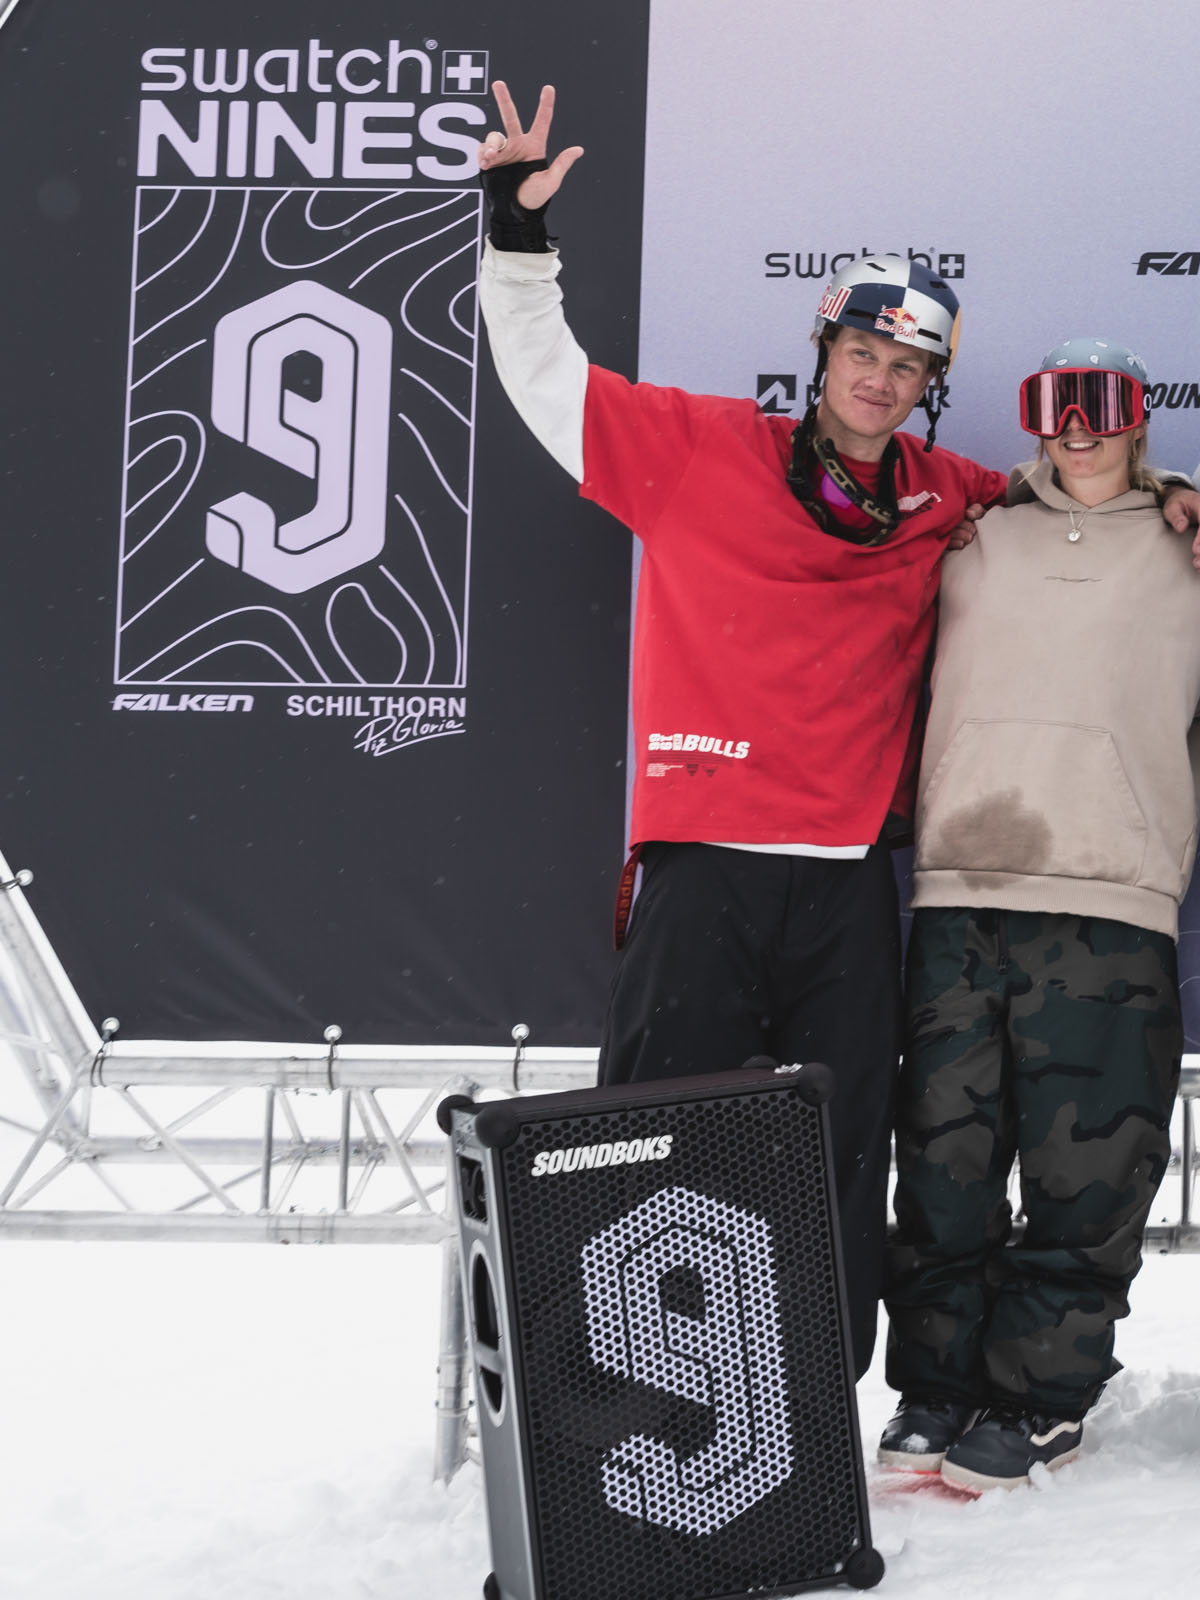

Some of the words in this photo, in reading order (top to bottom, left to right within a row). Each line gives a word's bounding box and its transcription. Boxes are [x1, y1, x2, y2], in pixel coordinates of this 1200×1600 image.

[140, 39, 432, 95] swatch
[137, 99, 487, 181] NINES
[874, 318, 896, 334] Red
[896, 324, 917, 340] Bull
[205, 280, 394, 594] 9
[110, 693, 254, 712] FALKEN
[286, 695, 467, 718] SCHILTHORN
[354, 715, 397, 756] Piz
[391, 711, 465, 744] Gloria
[531, 1134, 674, 1177] SOUNDBOKS
[580, 1186, 795, 1537] 9
